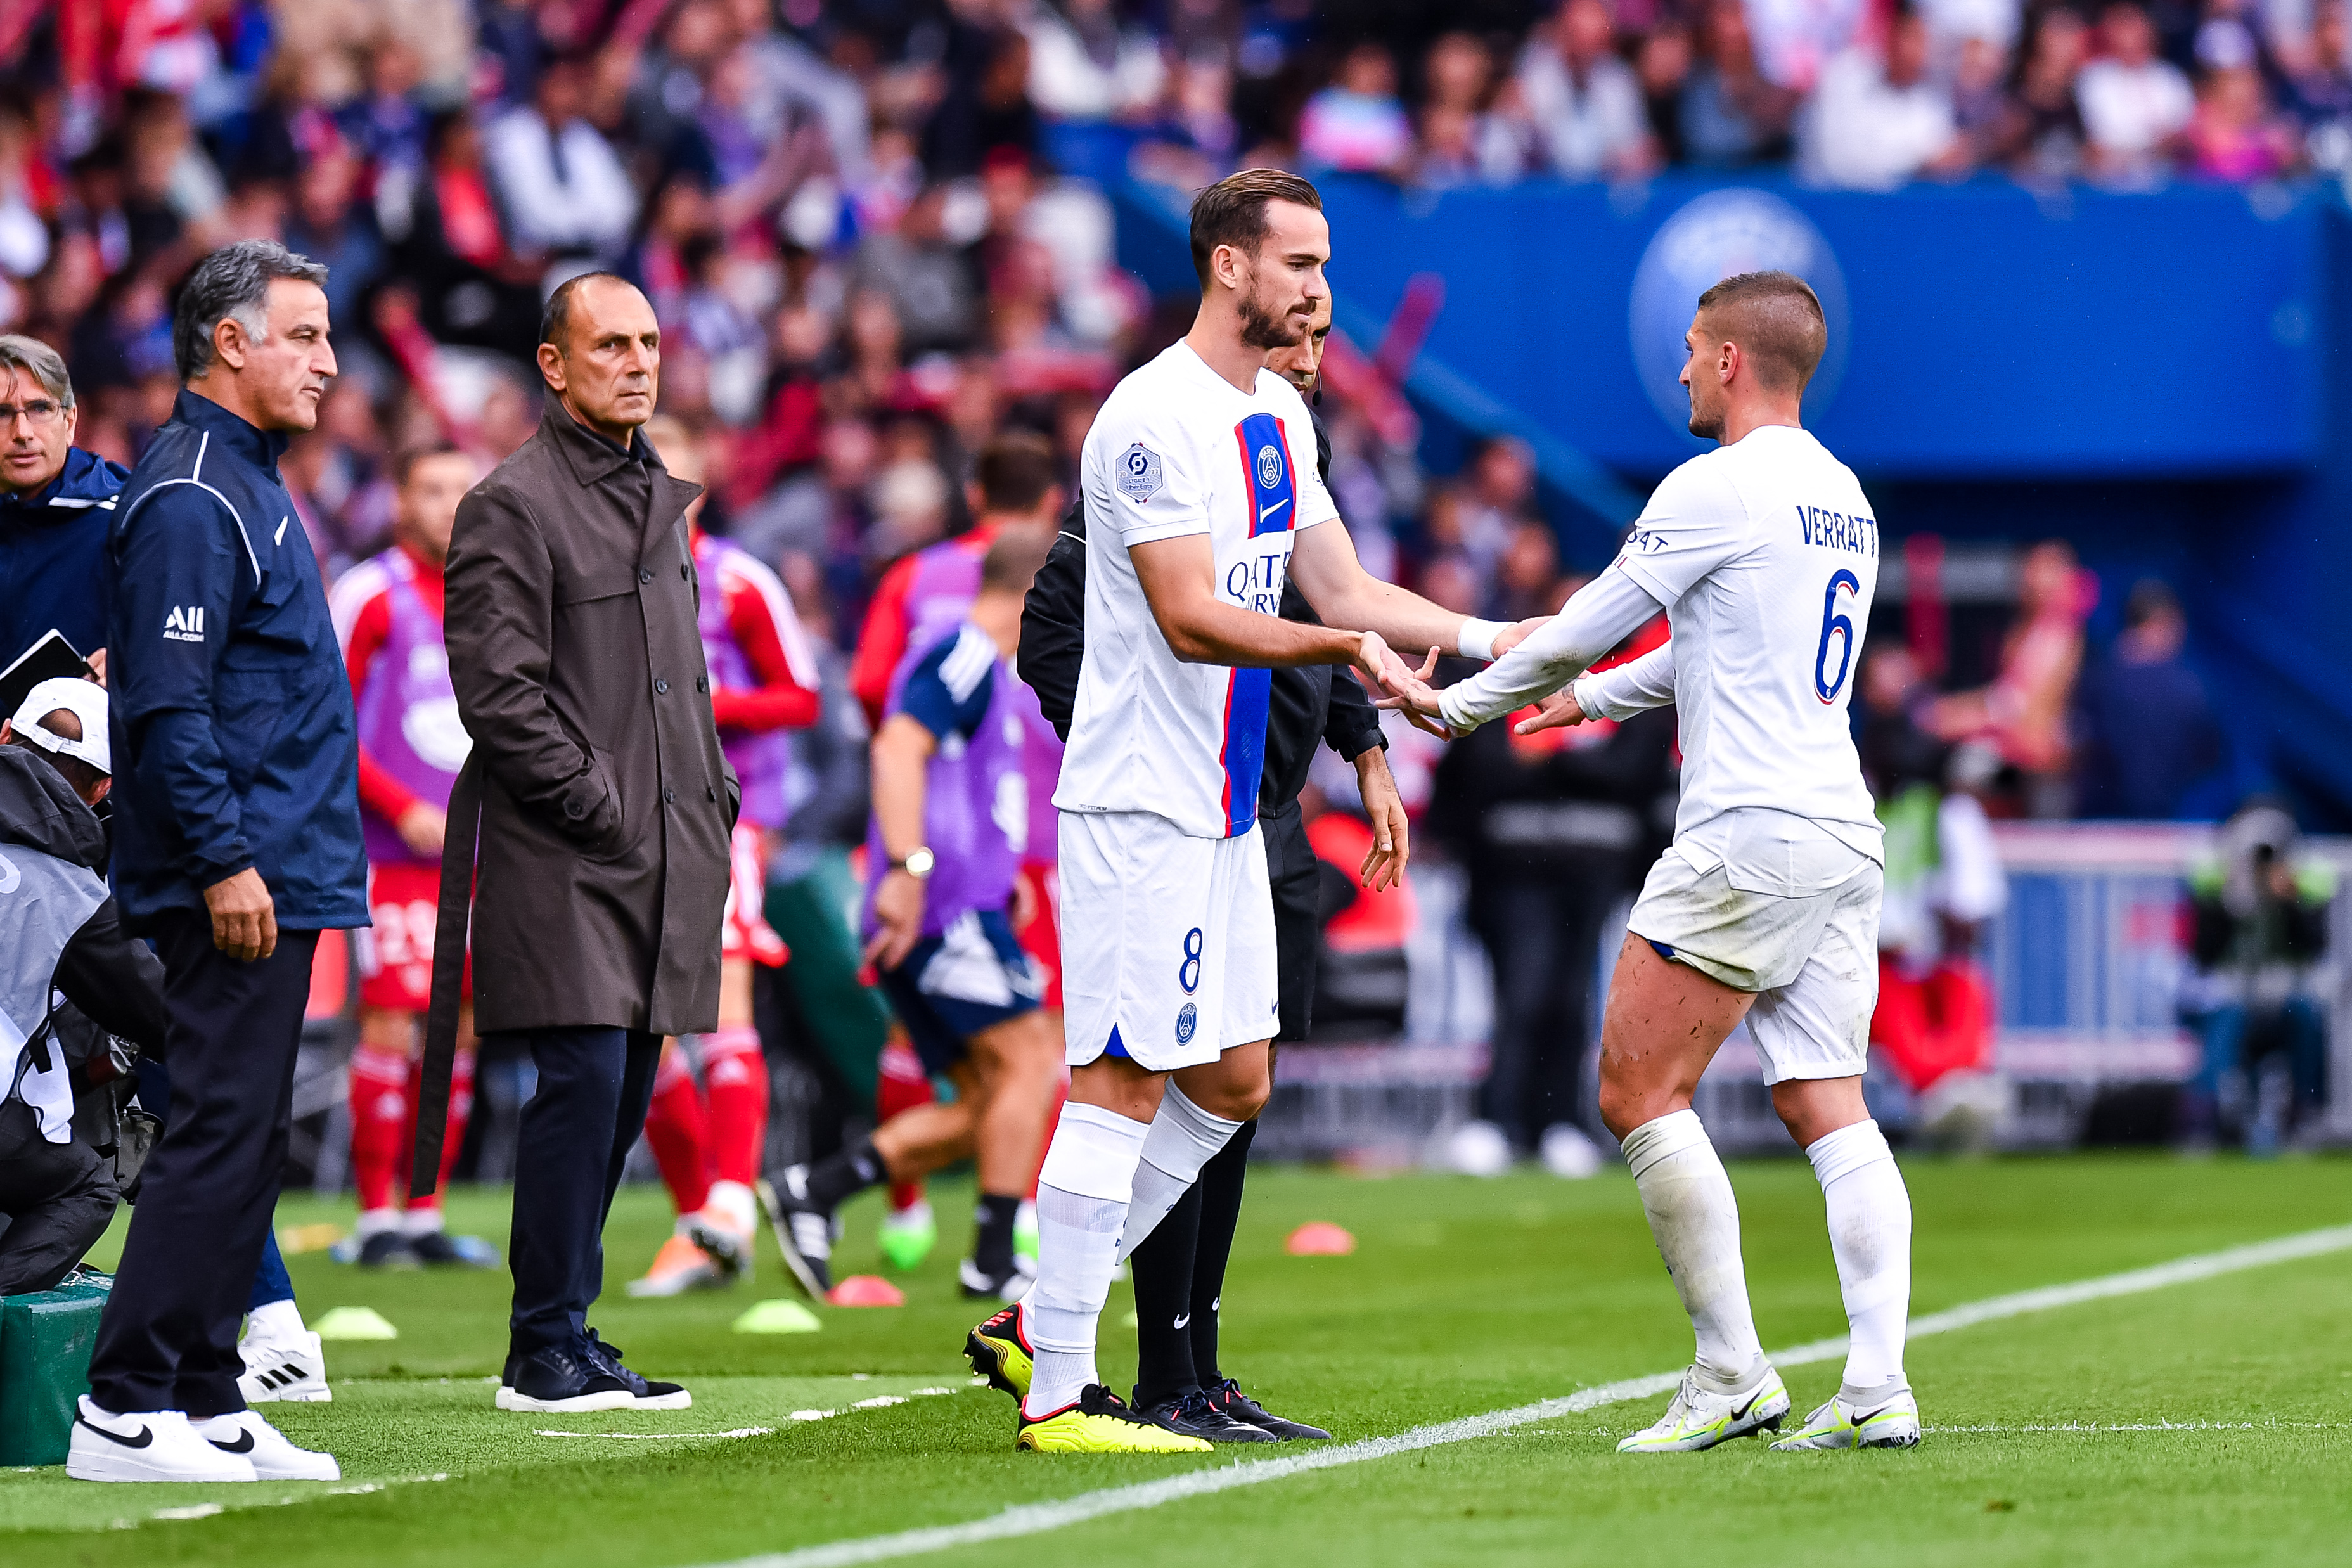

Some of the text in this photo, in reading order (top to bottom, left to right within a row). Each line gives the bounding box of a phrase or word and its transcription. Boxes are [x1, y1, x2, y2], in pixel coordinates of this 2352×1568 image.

[1796, 505, 1875, 558] VERRATT
[1814, 569, 1860, 705] 6
[1178, 927, 1203, 996] 8
